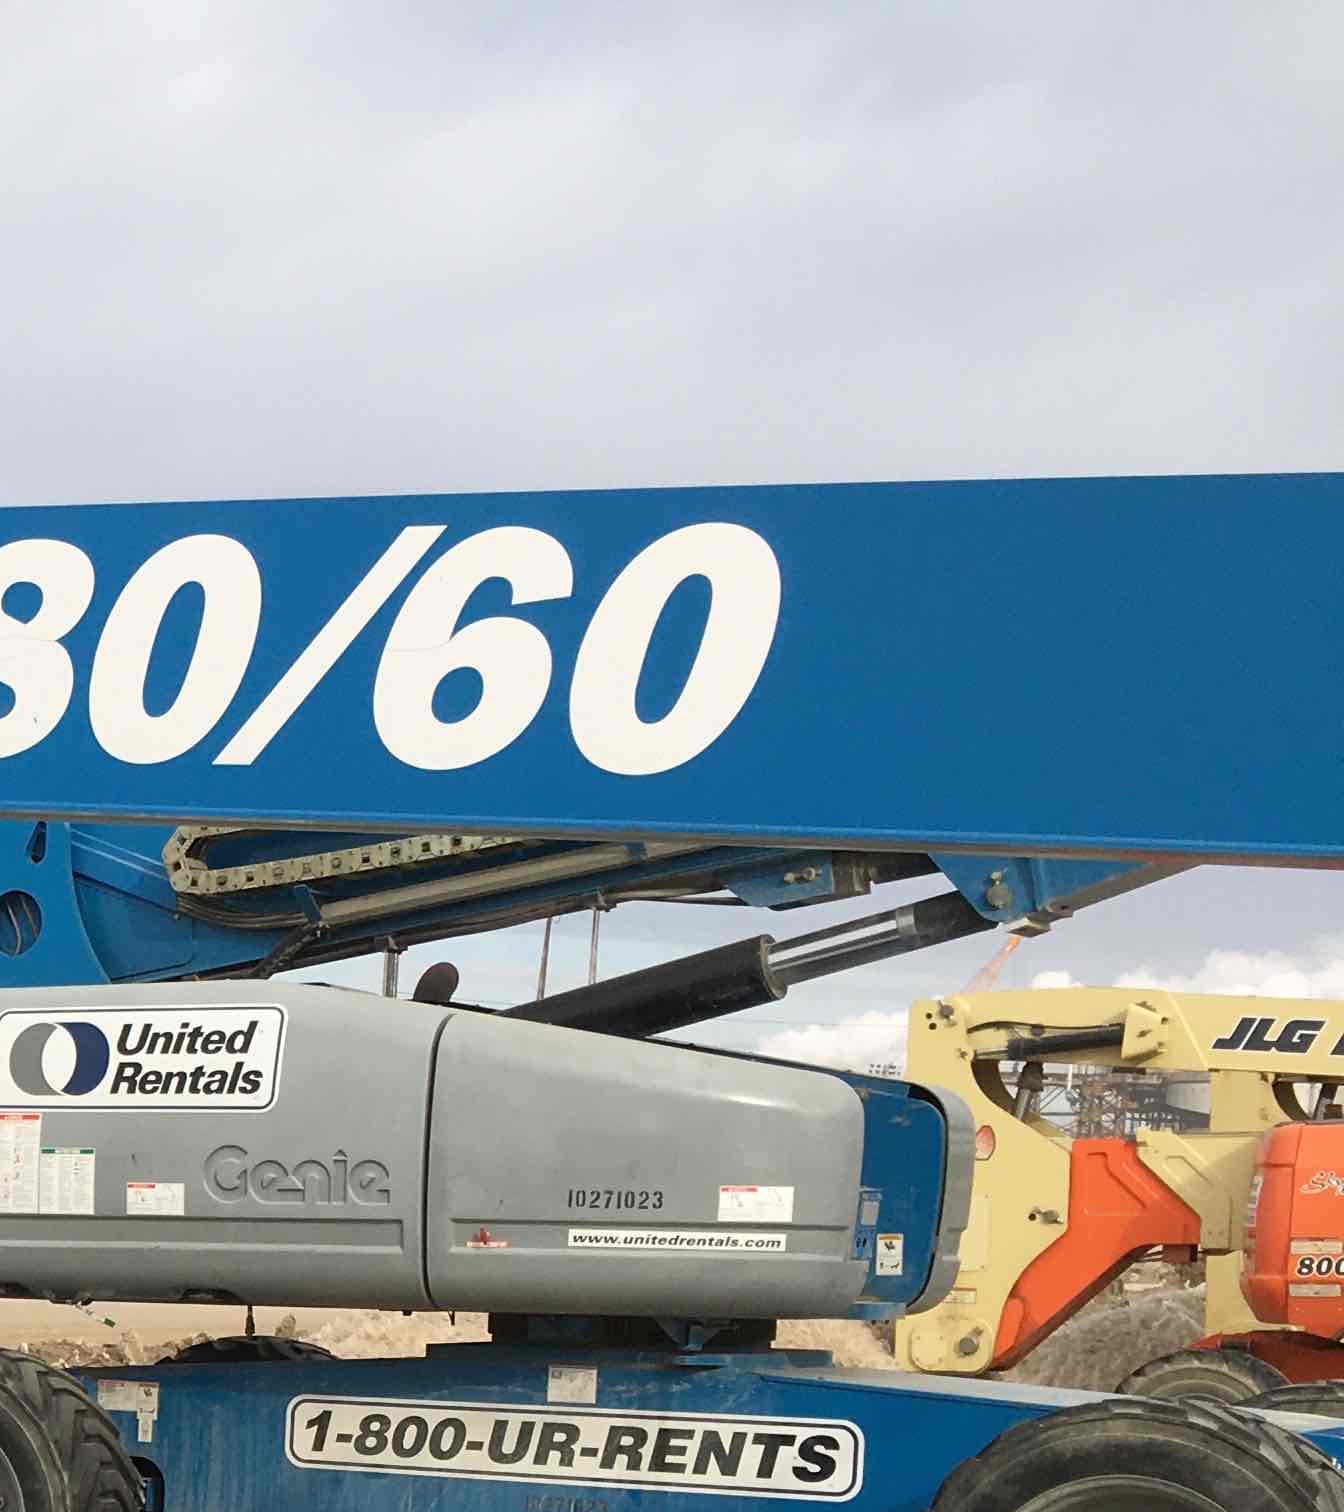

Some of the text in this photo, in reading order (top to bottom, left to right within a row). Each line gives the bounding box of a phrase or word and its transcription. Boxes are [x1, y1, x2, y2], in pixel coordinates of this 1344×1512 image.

[115, 1020, 260, 1055] United
[1211, 1017, 1327, 1054] JLG
[109, 1060, 264, 1096] Rentals
[202, 1143, 392, 1206] Genie
[568, 1188, 664, 1210] 10271023
[572, 1231, 783, 1250] www.unitedrentals.com
[301, 1409, 842, 1486] 1-800-UR-RENTS
